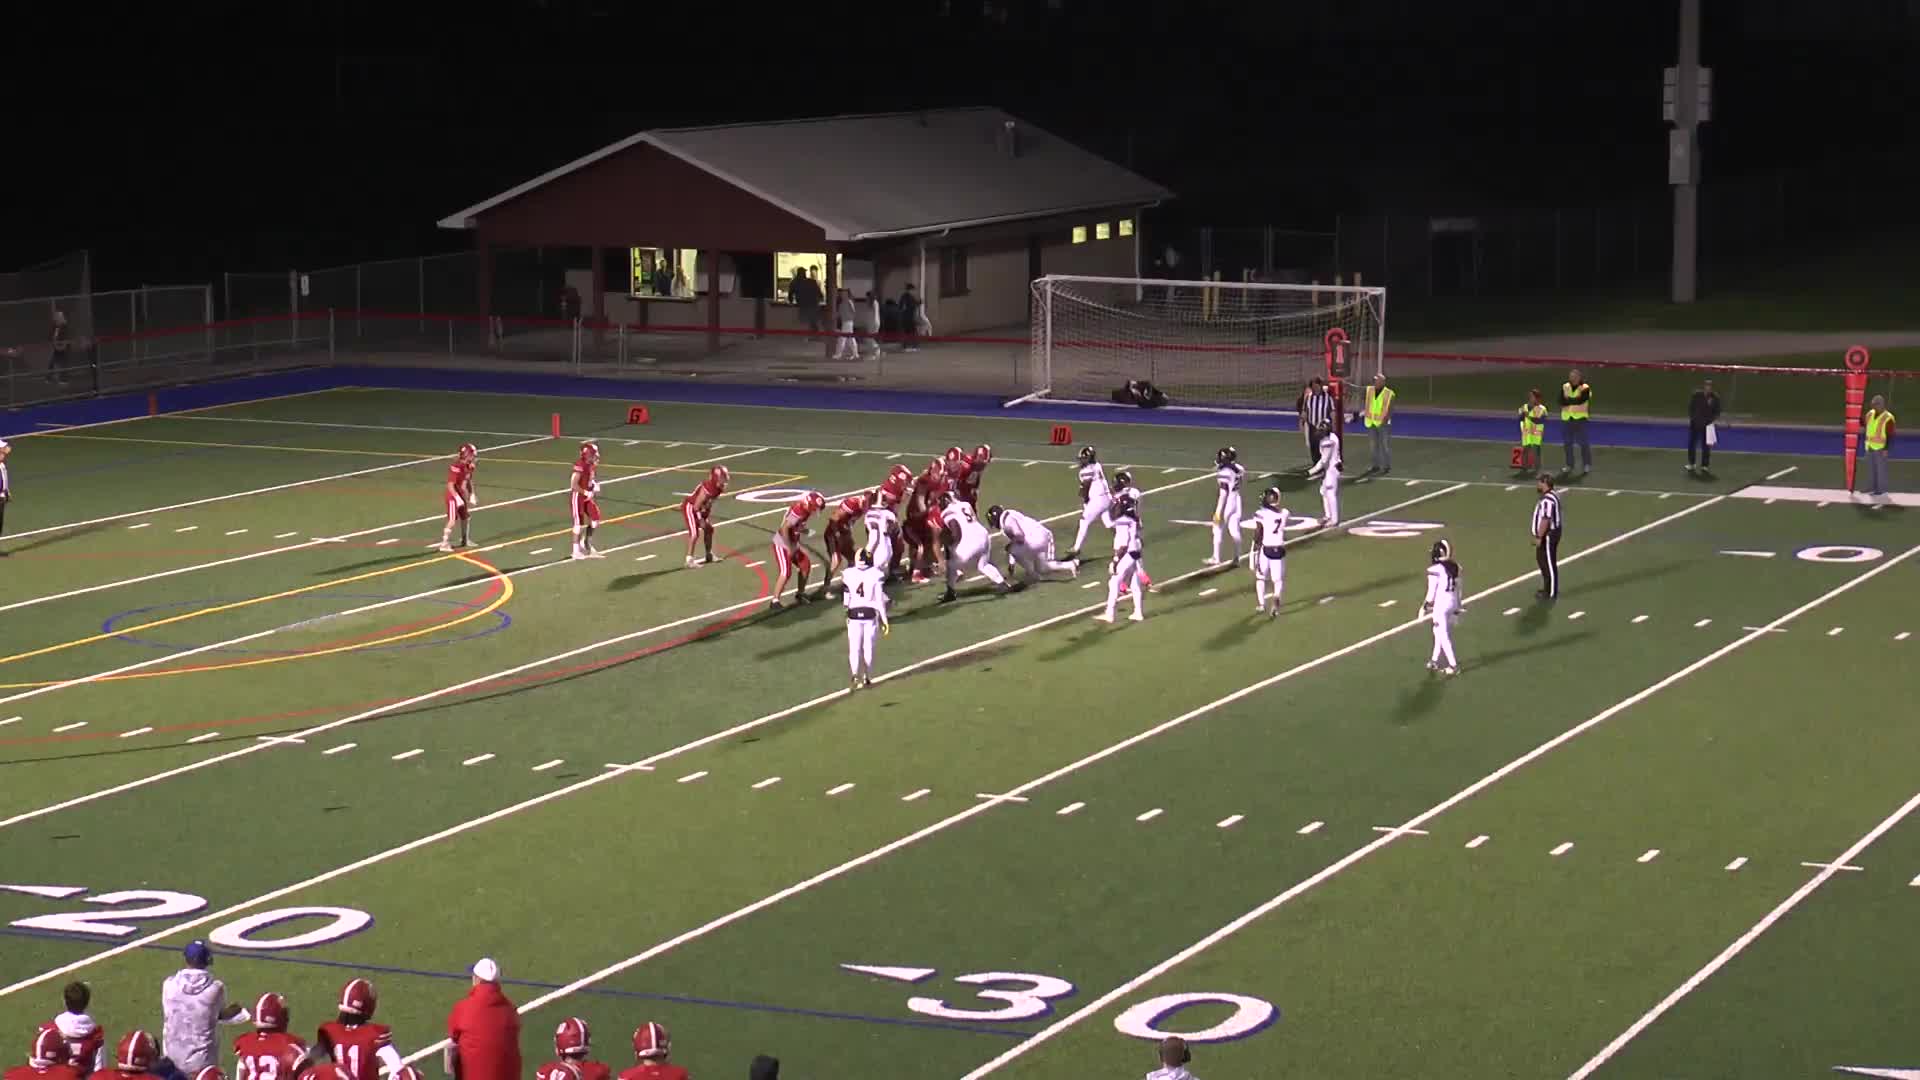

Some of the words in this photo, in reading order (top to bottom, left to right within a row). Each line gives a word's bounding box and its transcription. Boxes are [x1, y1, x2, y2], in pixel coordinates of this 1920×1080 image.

[629, 407, 643, 424] G
[1053, 426, 1068, 442] 10
[1272, 518, 1282, 534] 7
[856, 581, 865, 597] 4
[8, 889, 374, 950] 20
[907, 971, 1280, 1044] 30
[334, 1043, 359, 1077] 11
